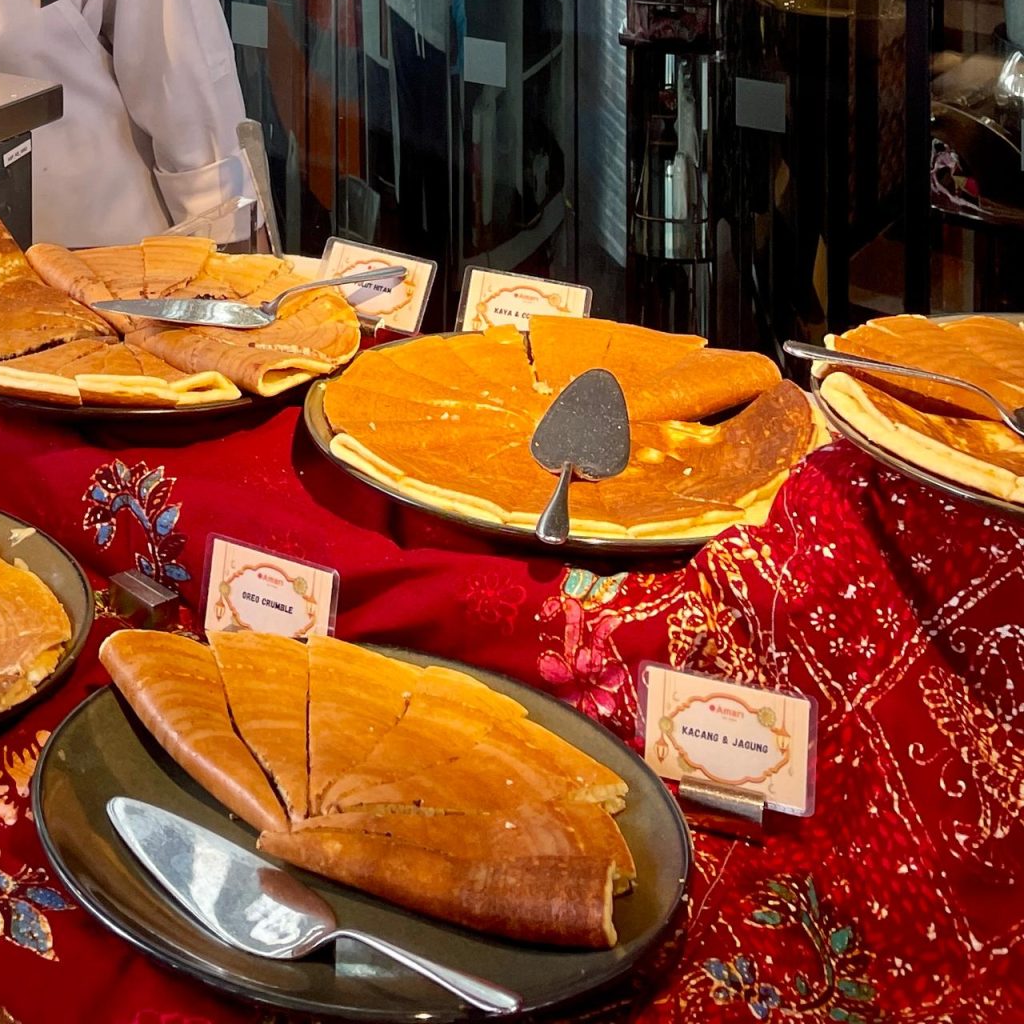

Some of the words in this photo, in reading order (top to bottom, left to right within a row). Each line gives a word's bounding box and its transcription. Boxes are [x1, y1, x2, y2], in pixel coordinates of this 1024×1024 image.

[493, 307, 512, 317] KAYA
[242, 591, 260, 603] OREO
[261, 598, 293, 614] CRUMBLE
[682, 726, 719, 742] KACANG
[722, 735, 729, 745] &
[732, 738, 768, 753] JAGUNG
